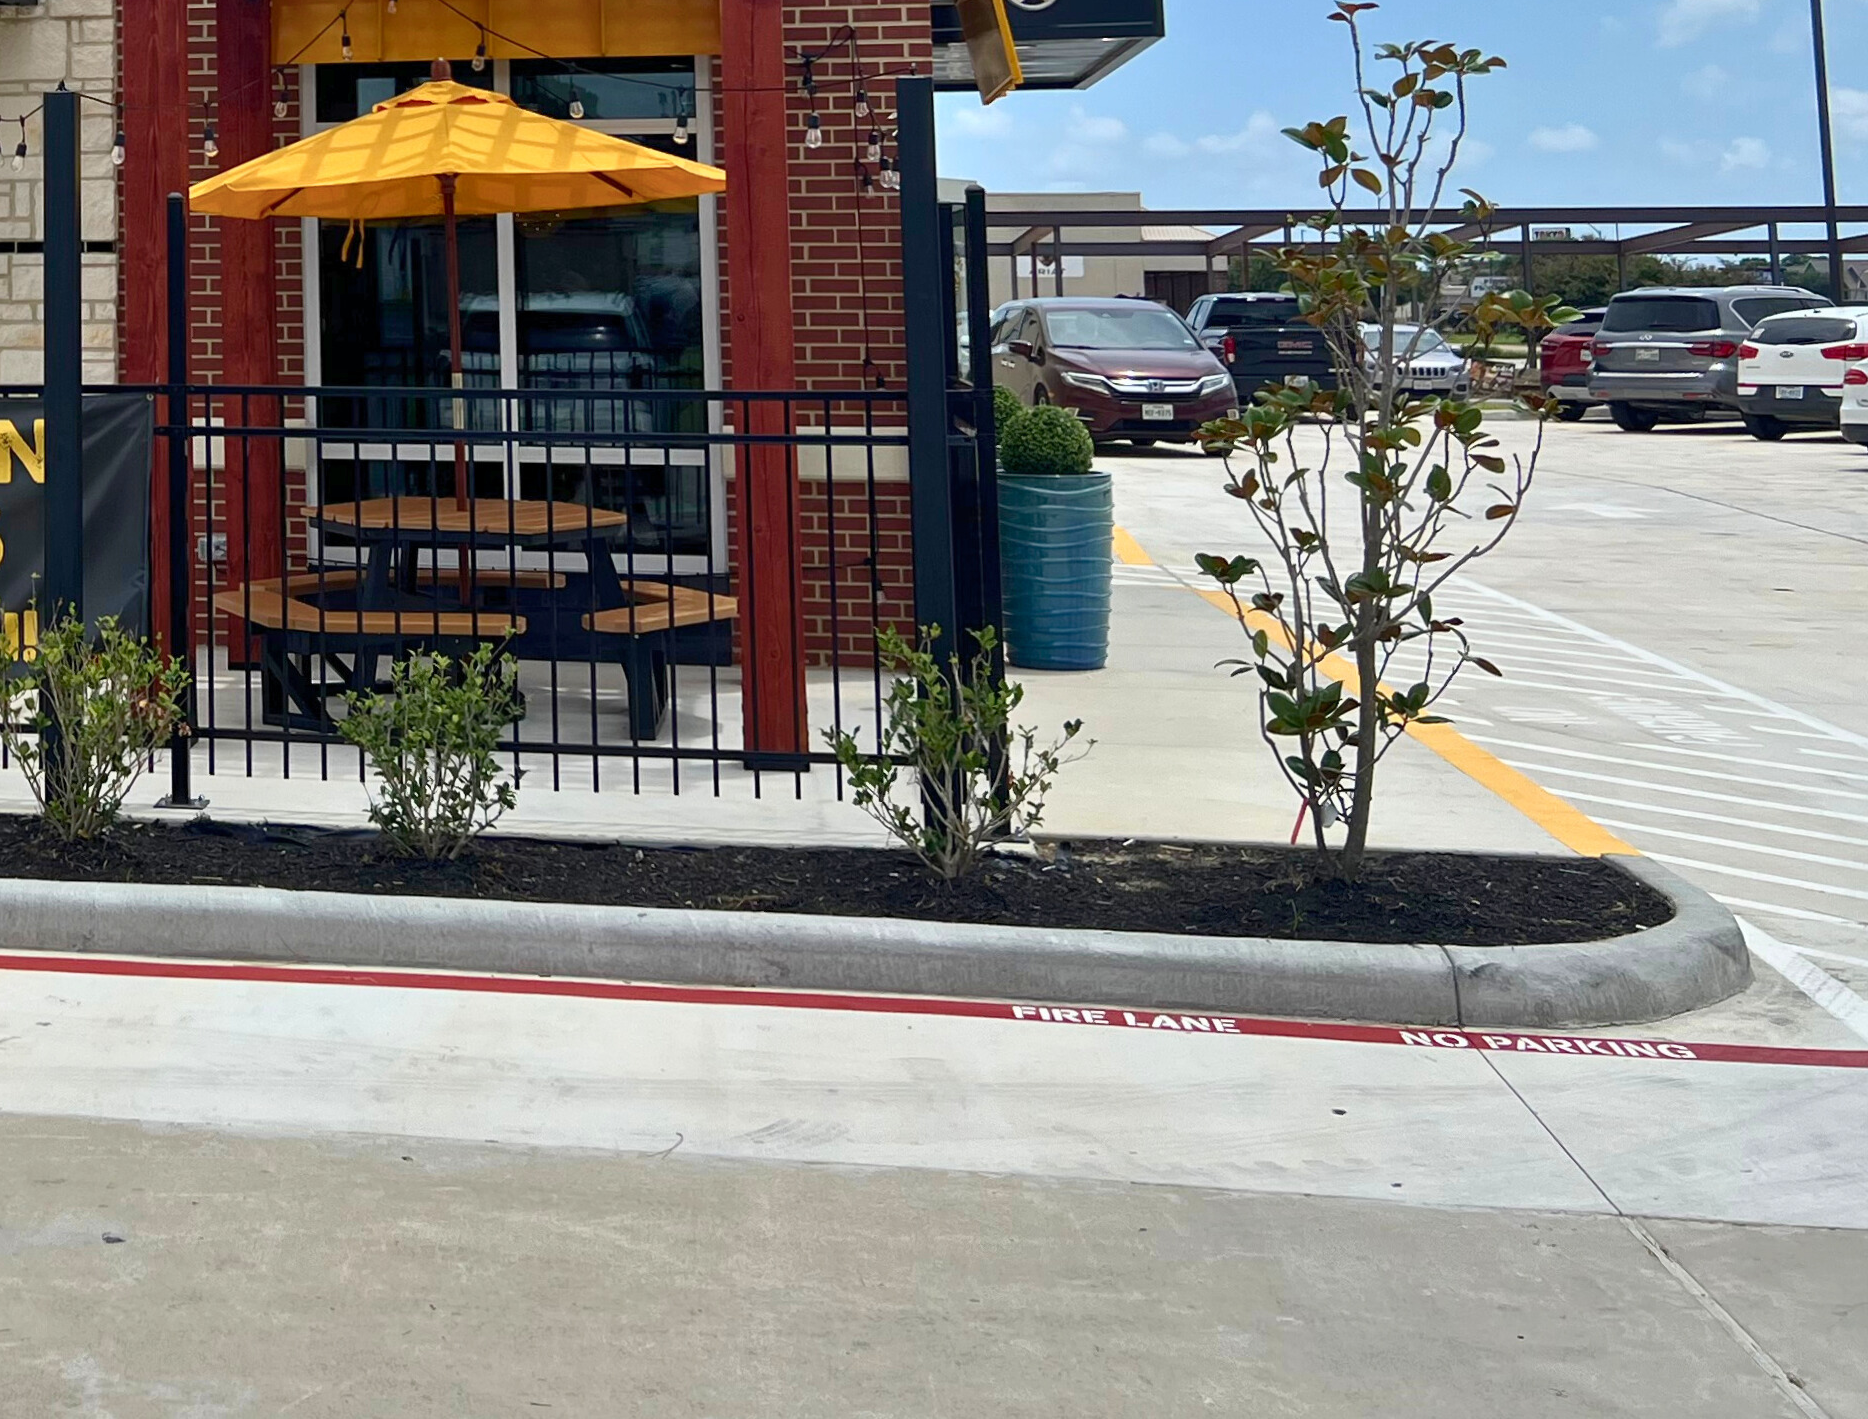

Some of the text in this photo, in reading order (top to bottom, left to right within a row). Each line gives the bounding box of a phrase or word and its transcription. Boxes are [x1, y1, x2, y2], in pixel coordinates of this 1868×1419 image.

[1011, 1005, 1241, 1033] FIRE LANE
[1399, 1030, 1698, 1060] NO PARKING
